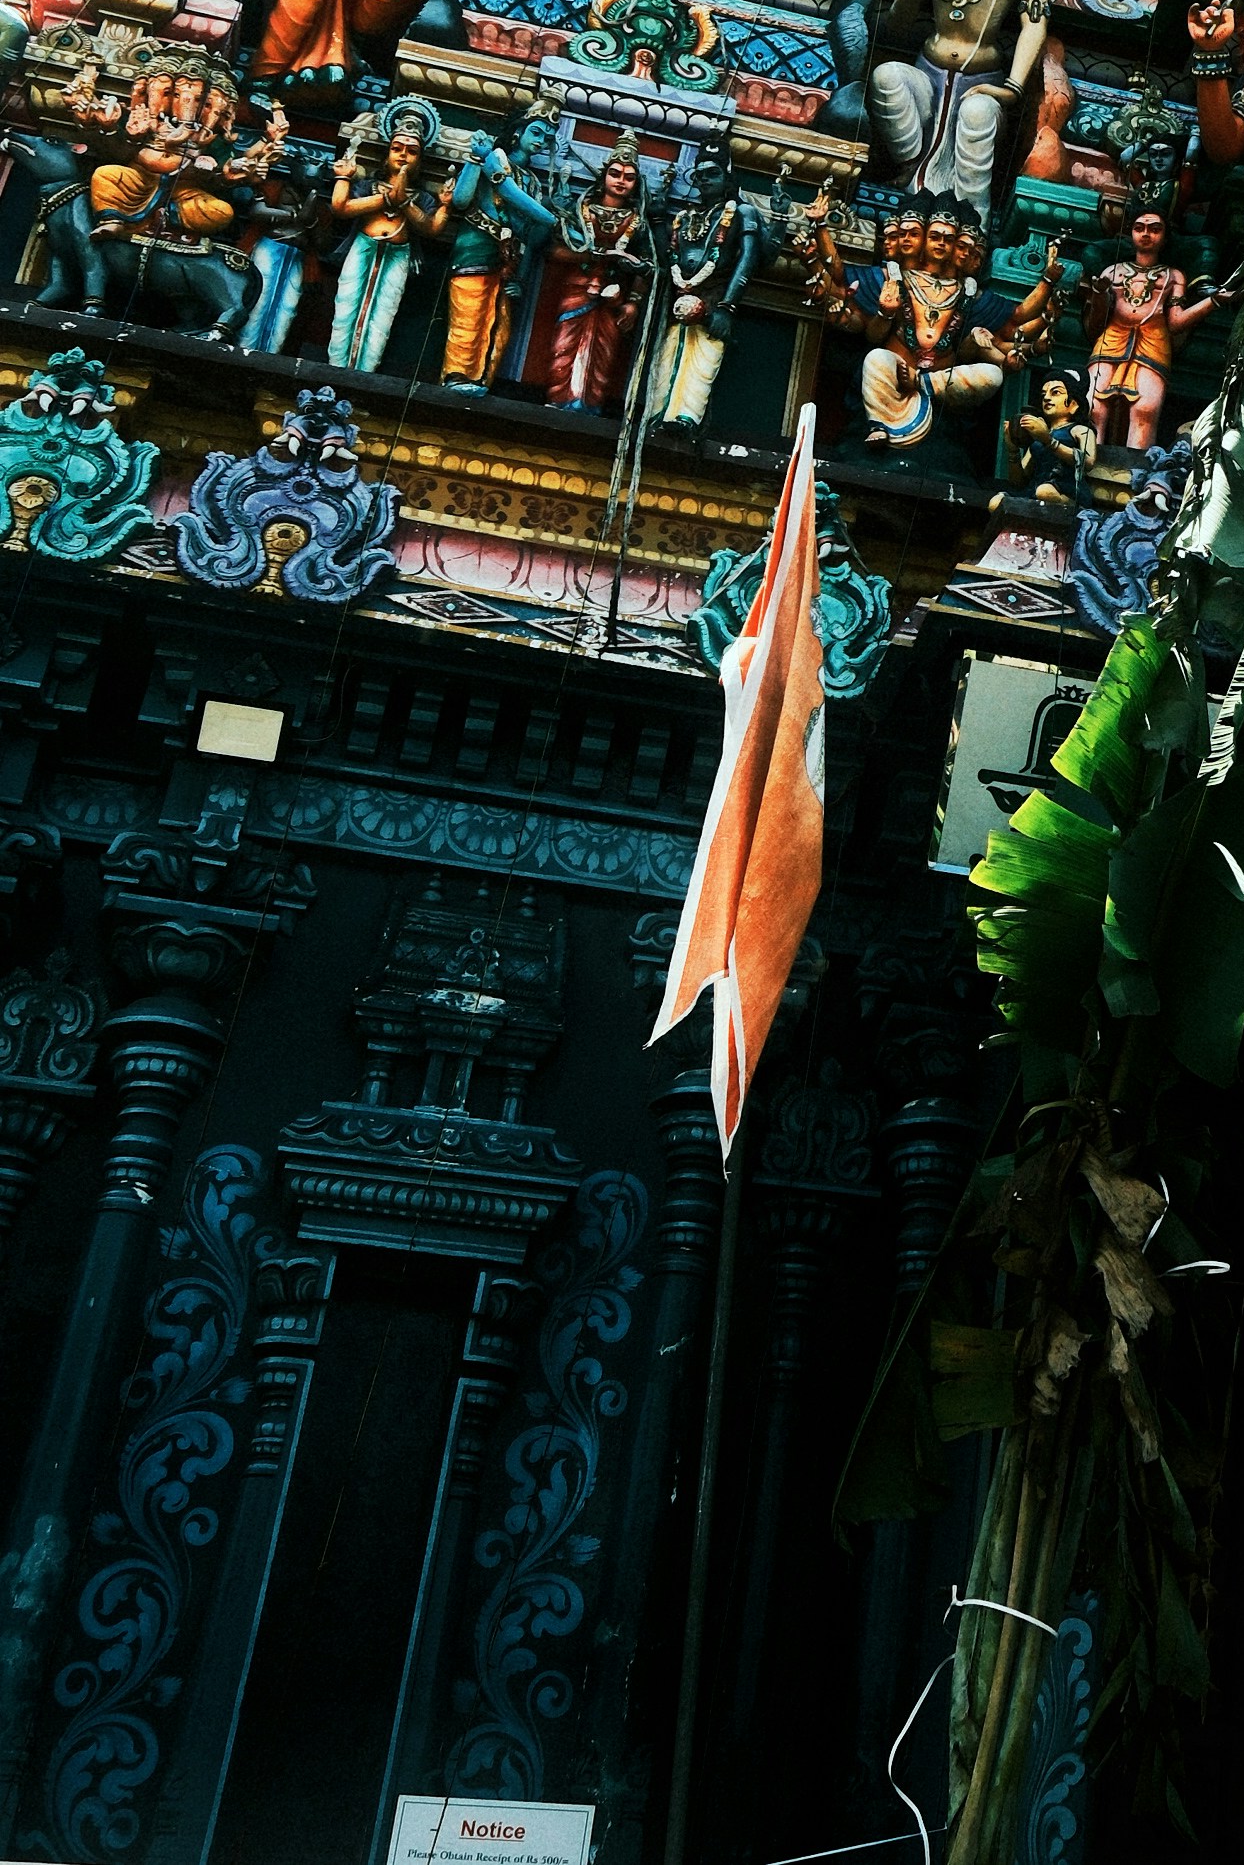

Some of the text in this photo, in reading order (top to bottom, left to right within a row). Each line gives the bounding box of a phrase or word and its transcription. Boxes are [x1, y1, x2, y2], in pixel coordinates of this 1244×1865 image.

[460, 1819, 526, 1839] Notice
[407, 1848, 437, 1859] Please
[440, 1850, 473, 1862] Obtain
[476, 1852, 511, 1864] Receipt
[514, 1853, 525, 1864] of
[527, 1855, 539, 1865] Rs
